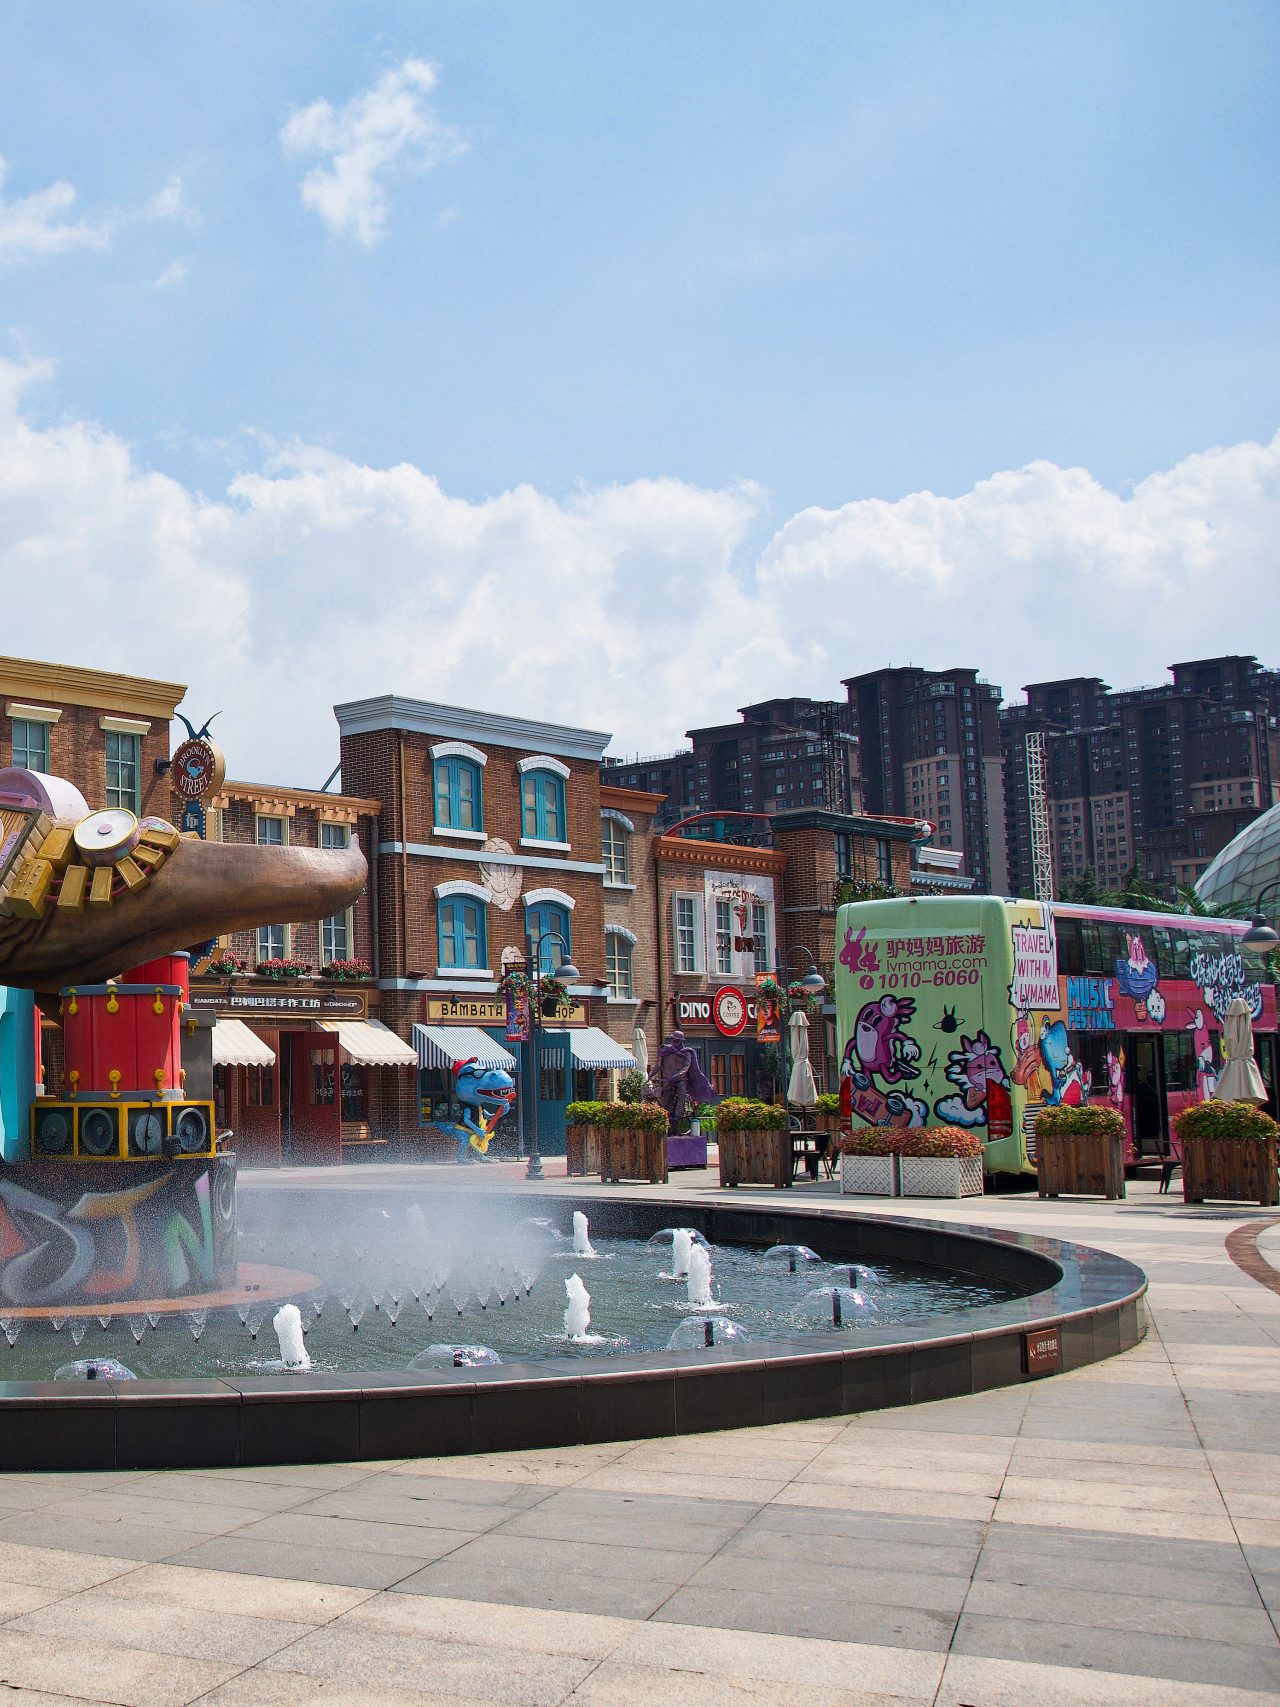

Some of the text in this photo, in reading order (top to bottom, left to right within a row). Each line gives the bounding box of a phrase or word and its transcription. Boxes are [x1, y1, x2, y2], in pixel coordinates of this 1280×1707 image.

[178, 746, 210, 768] BROOKLYN
[180, 773, 208, 795] STREET
[886, 934, 986, 959] 驴妈妈旅游
[1015, 933, 1050, 953] TRAVEL
[886, 957, 987, 973] lvmama.com
[878, 969, 980, 990] 1010-6060
[1020, 984, 1058, 1003] LVMAMA
[1067, 976, 1114, 1009] MUSIC
[441, 1003, 503, 1016] BAMBATA
[680, 1002, 710, 1019] DINO
[1068, 1009, 1115, 1029] FESTIVAL
